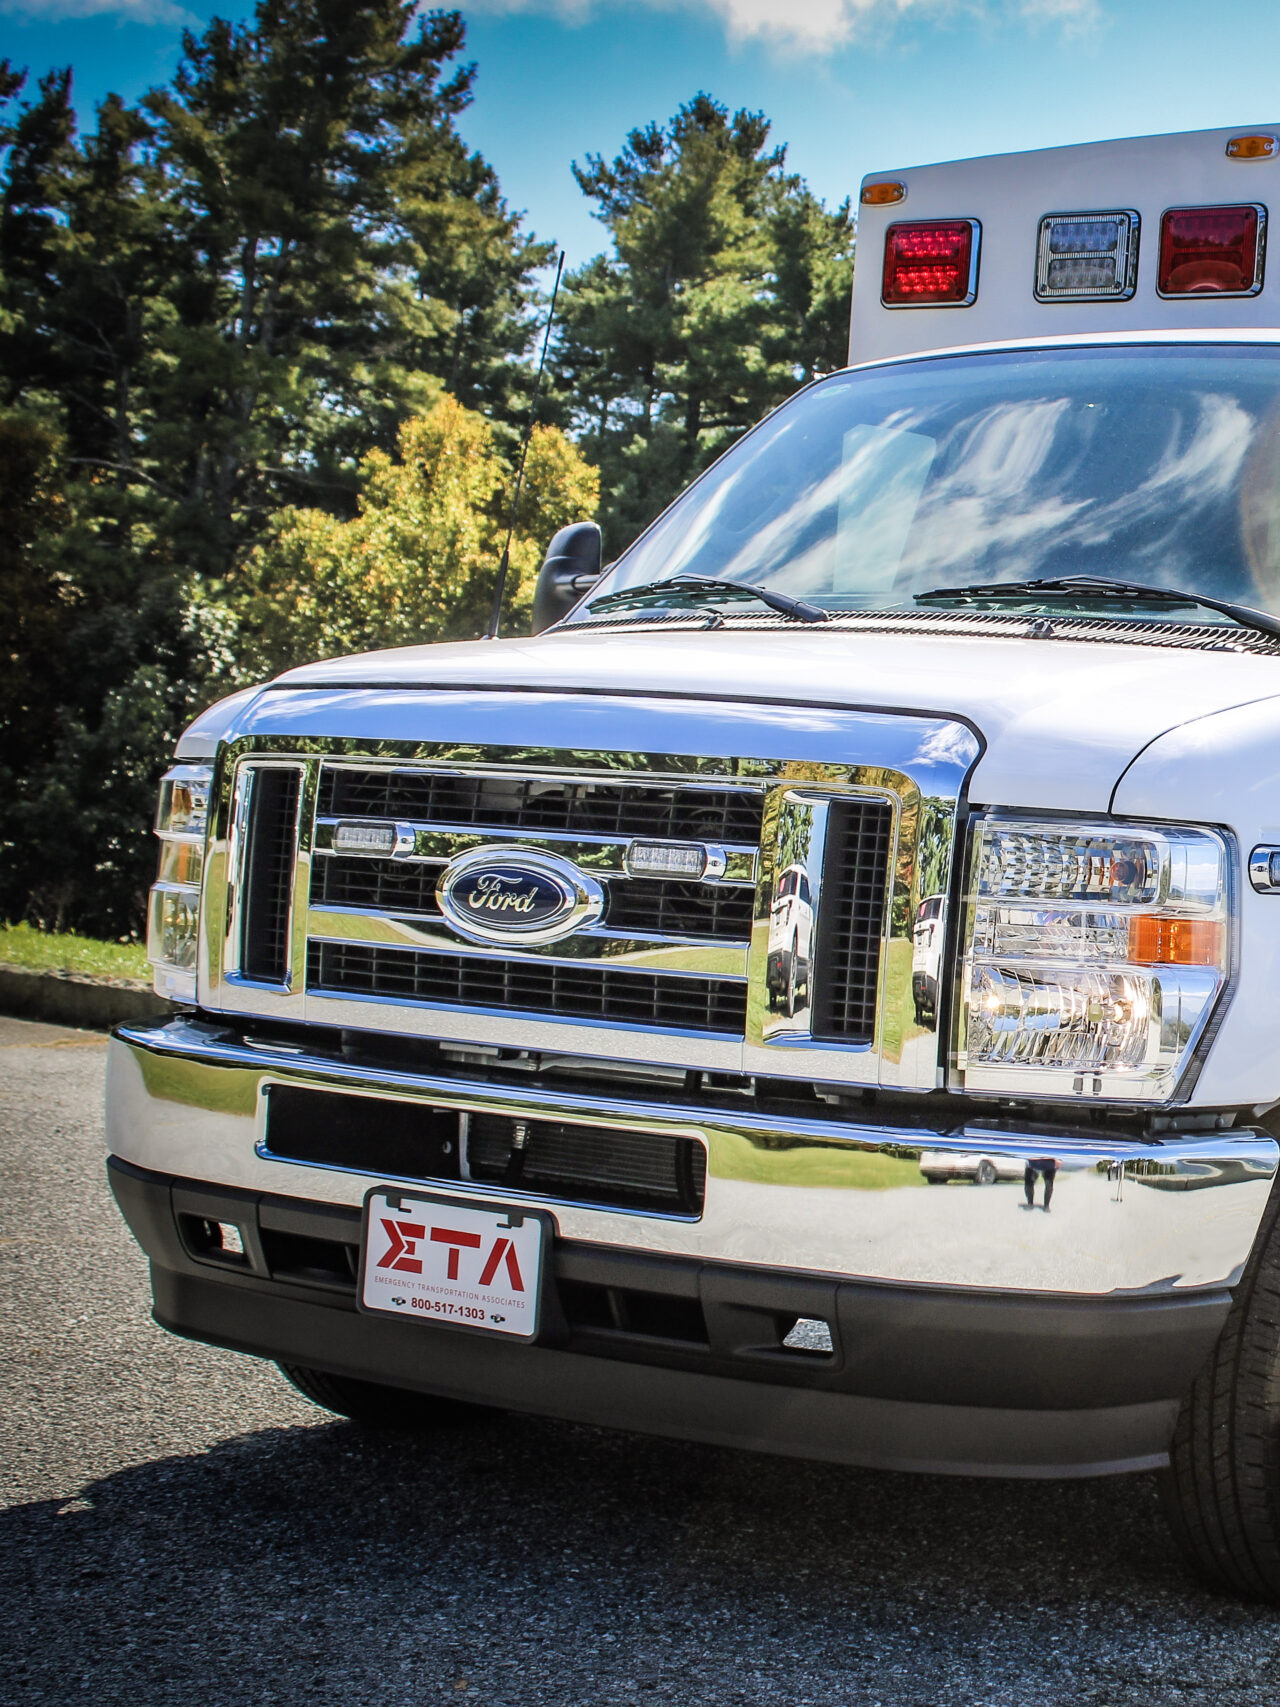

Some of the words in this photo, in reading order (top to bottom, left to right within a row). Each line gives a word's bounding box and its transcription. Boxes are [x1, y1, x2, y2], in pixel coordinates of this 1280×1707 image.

[468, 873, 539, 913] Ford
[375, 1217, 526, 1293] ETA
[374, 1275, 416, 1290] EMERGENCY
[417, 1282, 480, 1301] TRANSPORTATION
[481, 1294, 526, 1309] ASSOCIATES
[410, 1297, 486, 1321] 800-517-1303
